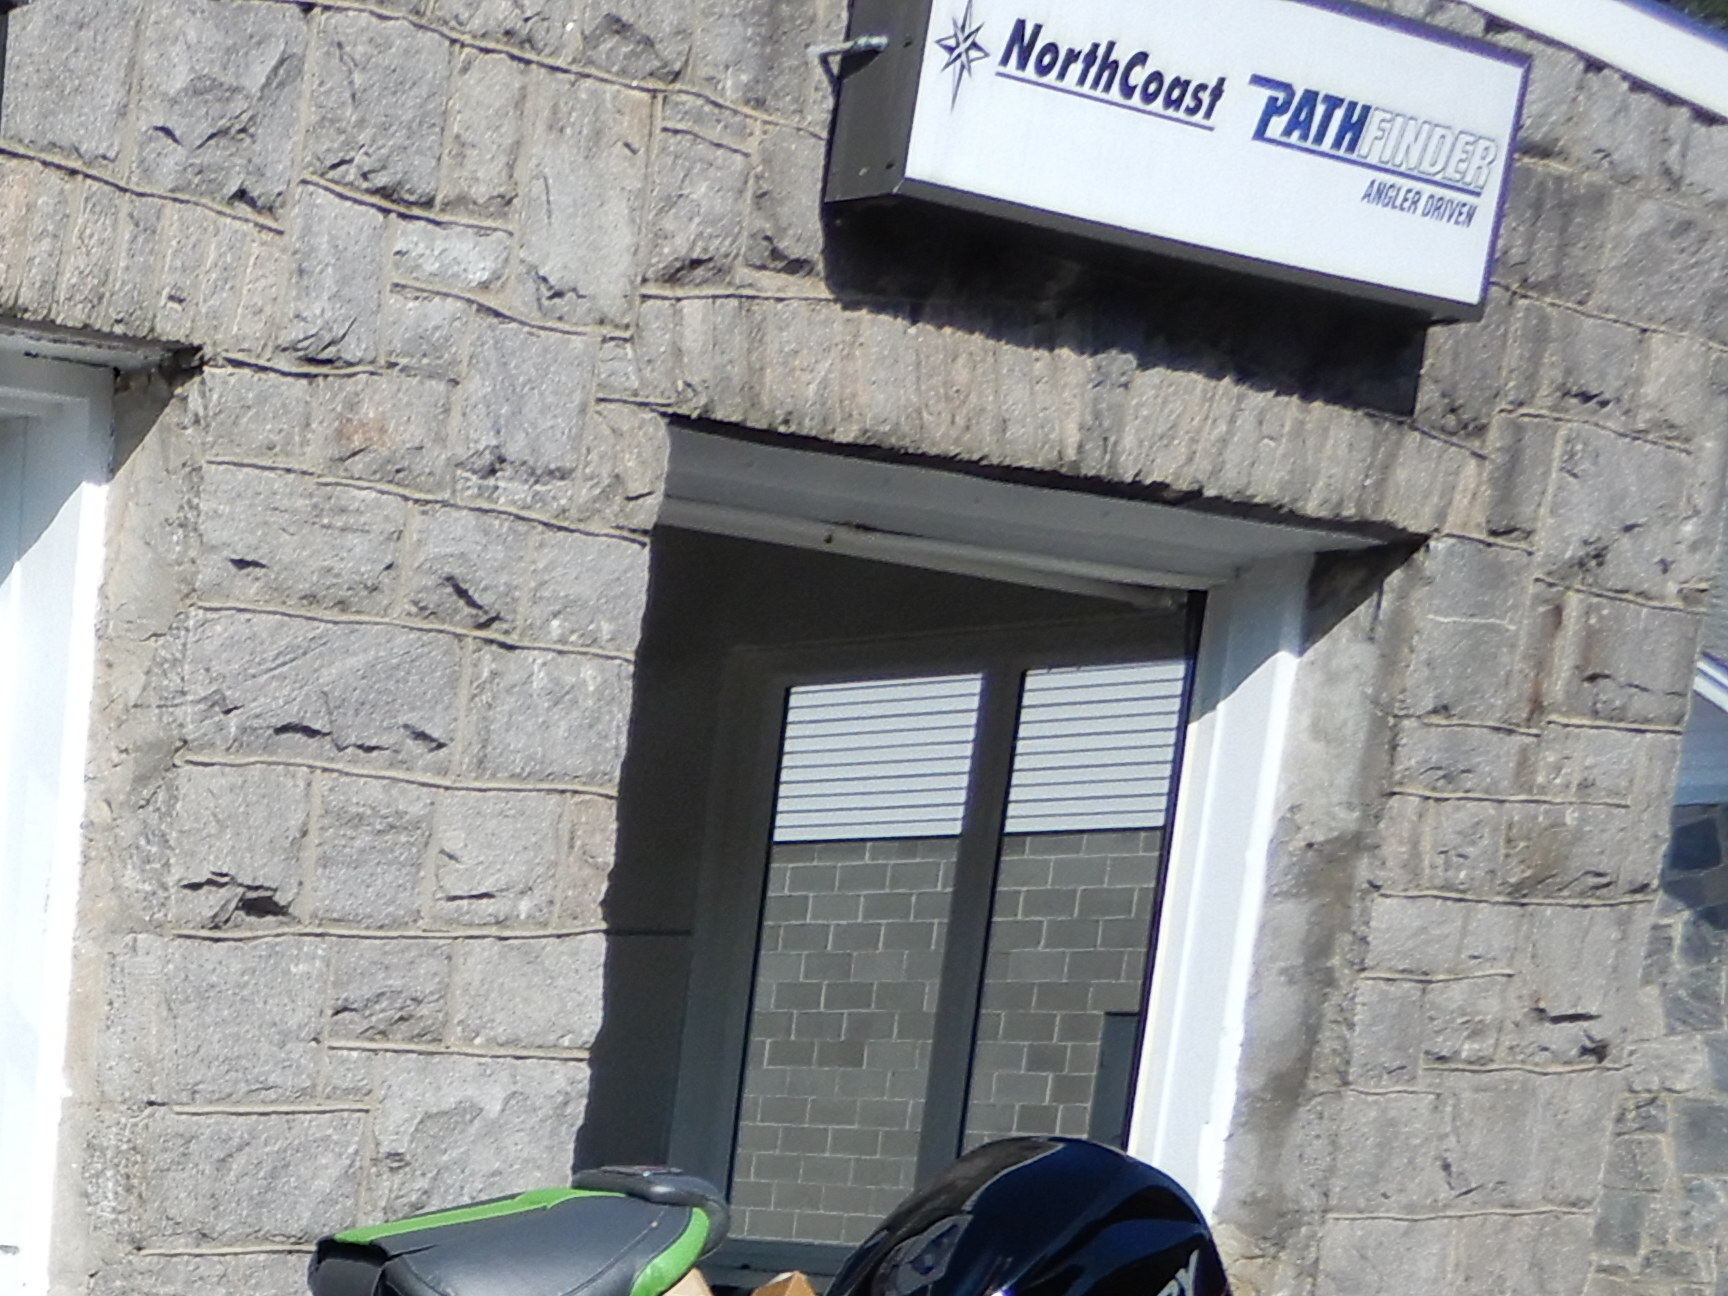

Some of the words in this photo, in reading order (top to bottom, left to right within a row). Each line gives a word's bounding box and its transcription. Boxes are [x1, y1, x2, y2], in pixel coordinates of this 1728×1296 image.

[997, 17, 1227, 121] NorthCoast
[1247, 73, 1499, 191] PATHFINDER
[1361, 178, 1420, 216] ANGLER
[1422, 194, 1478, 228] DRIVEN
